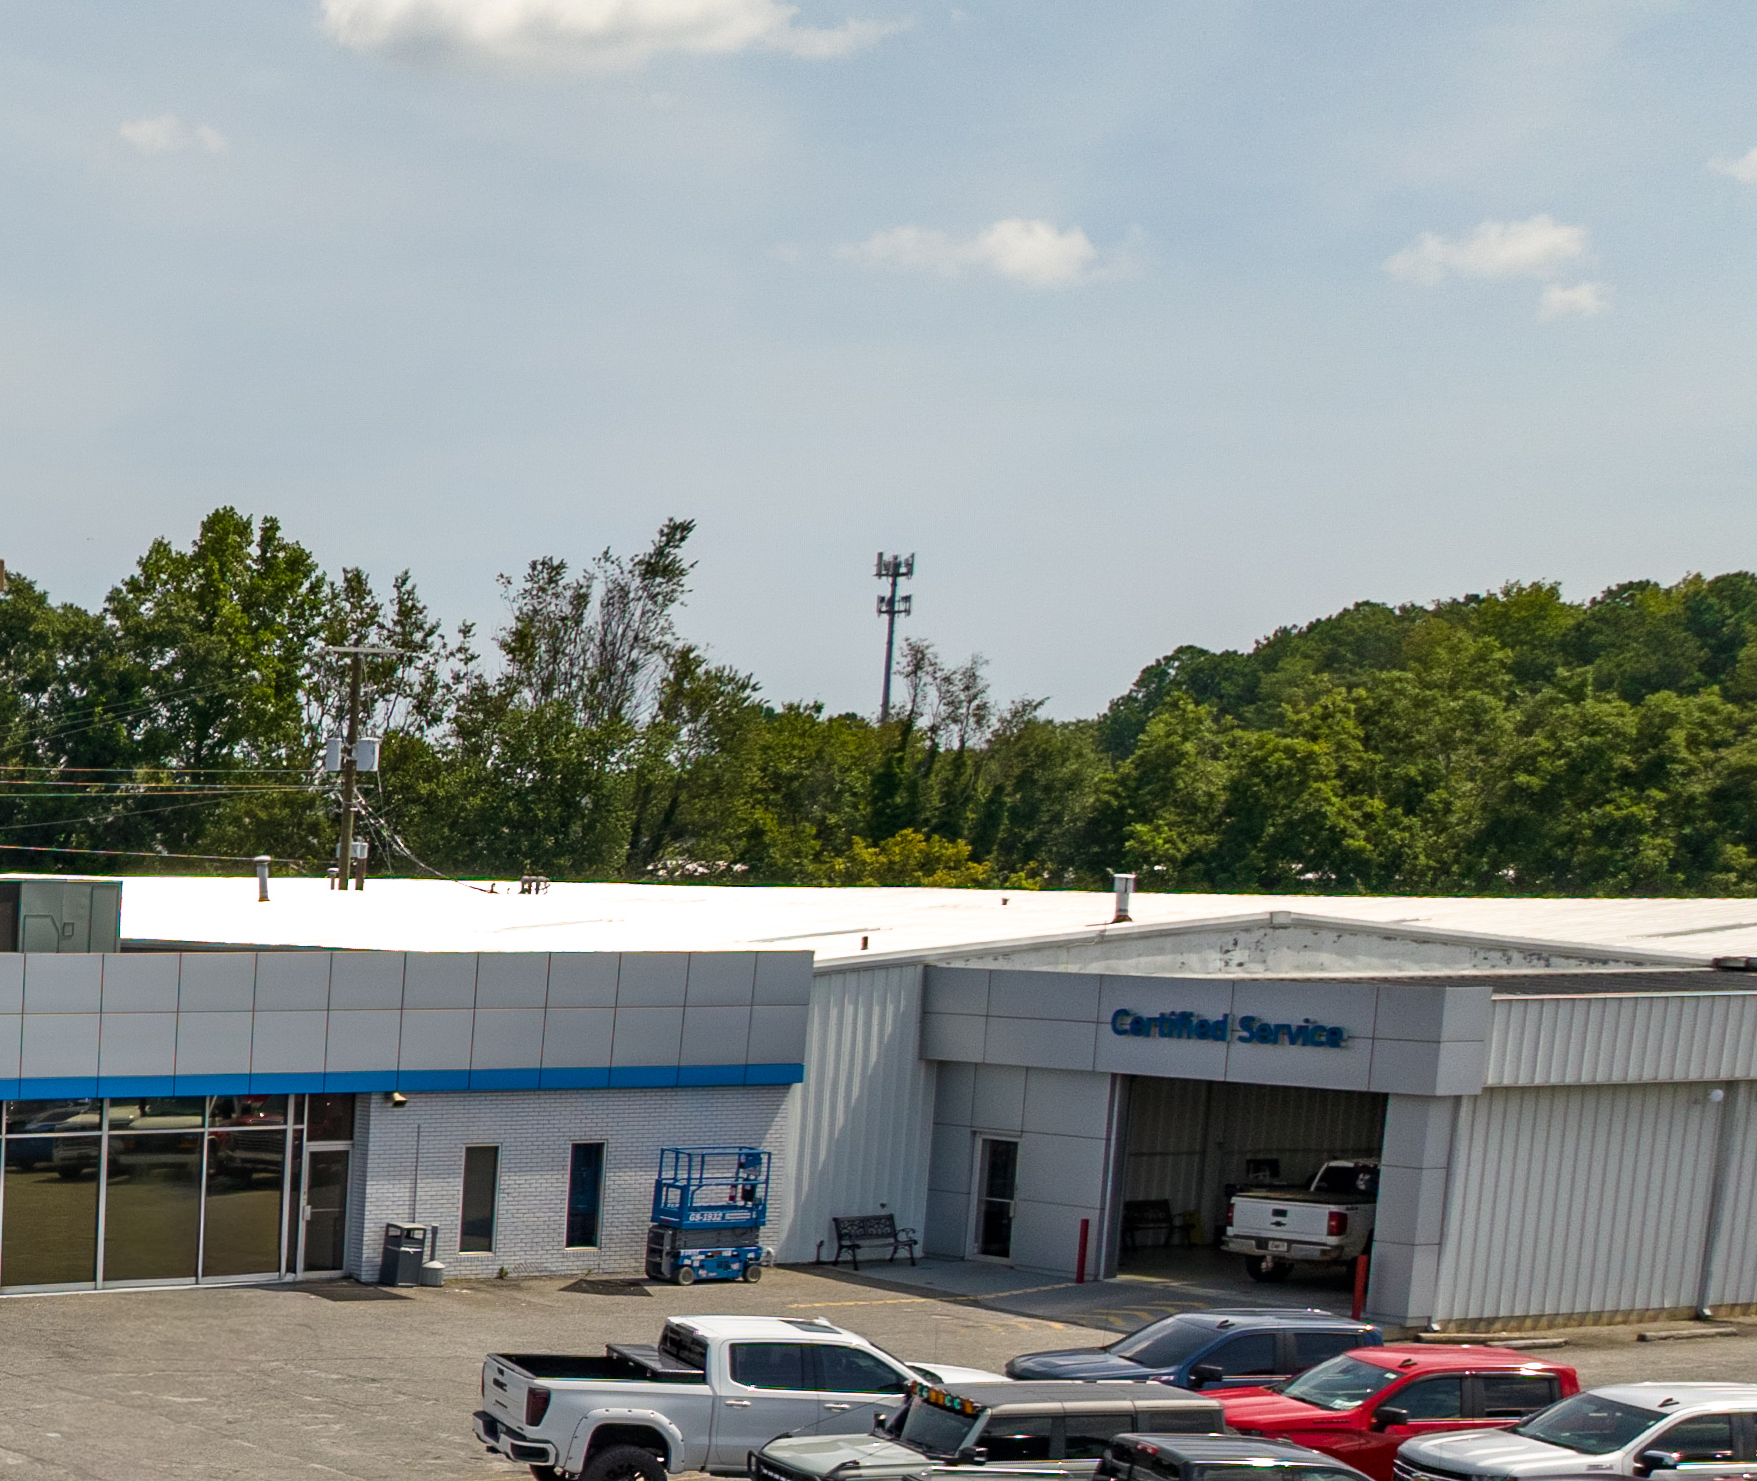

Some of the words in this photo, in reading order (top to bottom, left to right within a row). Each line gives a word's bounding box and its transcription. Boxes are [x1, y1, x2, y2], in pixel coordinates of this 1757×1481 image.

[1111, 1008, 1229, 1042] Certified
[1238, 1015, 1345, 1048] Service
[689, 1212, 723, 1222] GS-1932
